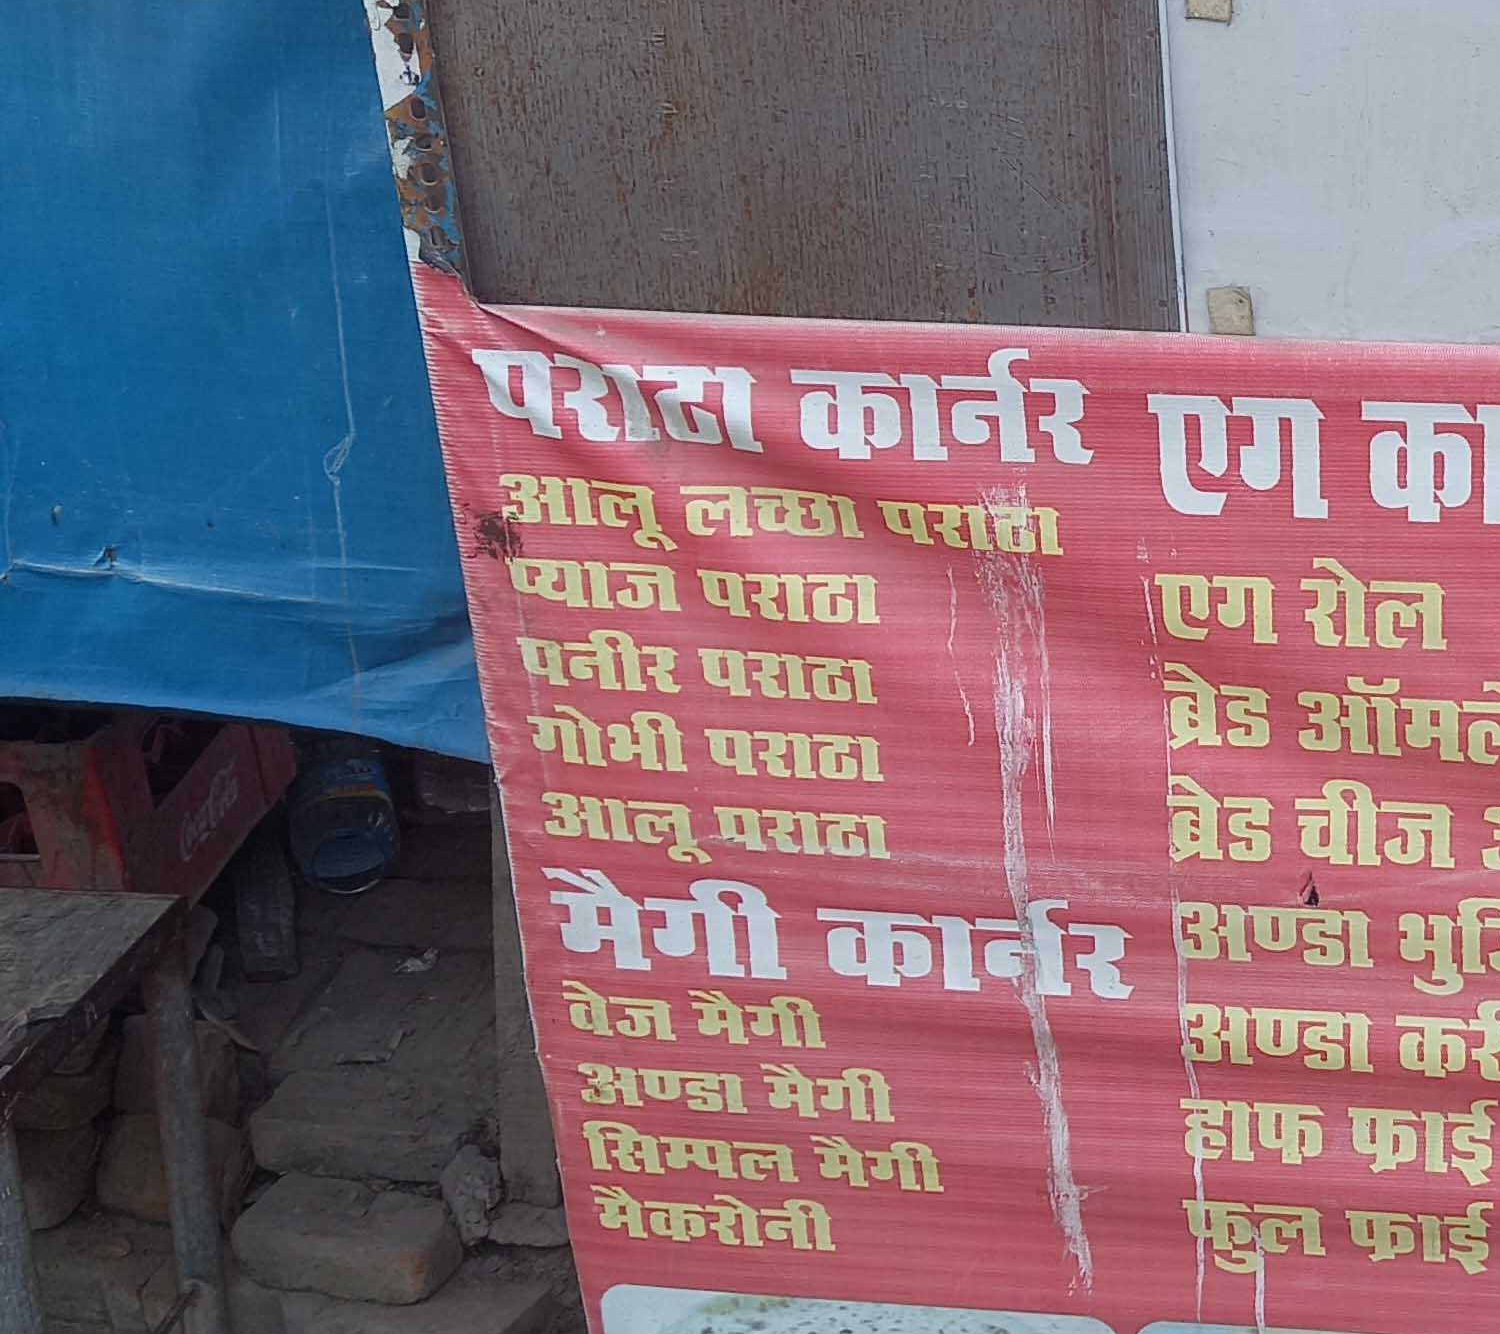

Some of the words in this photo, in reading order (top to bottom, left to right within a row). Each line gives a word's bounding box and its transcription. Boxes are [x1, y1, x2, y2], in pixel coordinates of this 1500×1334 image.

[789, 348, 1094, 465] कार्नर
[1147, 393, 1329, 519] एग
[500, 474, 677, 550] आलू
[680, 485, 864, 539] लच्छा
[876, 499, 1064, 556] पराठा
[505, 555, 682, 613] प्याज
[697, 568, 880, 624] पराठा
[1154, 573, 1279, 645] एग
[1300, 557, 1448, 651] रोल
[516, 629, 682, 694] पनीर
[697, 647, 878, 705] पराठा
[526, 705, 687, 772] गोभी
[704, 727, 884, 782] पराठा
[1162, 662, 1272, 750] ब्रेड
[541, 791, 711, 864] आलू
[712, 805, 890, 859] पराठा
[1166, 775, 1273, 864] ब्रेड
[1295, 779, 1456, 869] चीज
[541, 867, 787, 980] मैगी
[816, 898, 1135, 1000] कार्नर
[1177, 900, 1374, 969] अण्डा
[561, 980, 677, 1042] वेज
[688, 990, 827, 1049] मैगी
[1181, 1002, 1374, 1074] अण्डा
[576, 1062, 748, 1115] अण्डा
[760, 1063, 896, 1123] मैगी
[582, 1120, 800, 1184] सिम्पल
[809, 1136, 945, 1193] मैगी
[1180, 1099, 1325, 1164] हाफ
[590, 1186, 836, 1252] मैकरोनी
[1182, 1198, 1326, 1274] फुल
